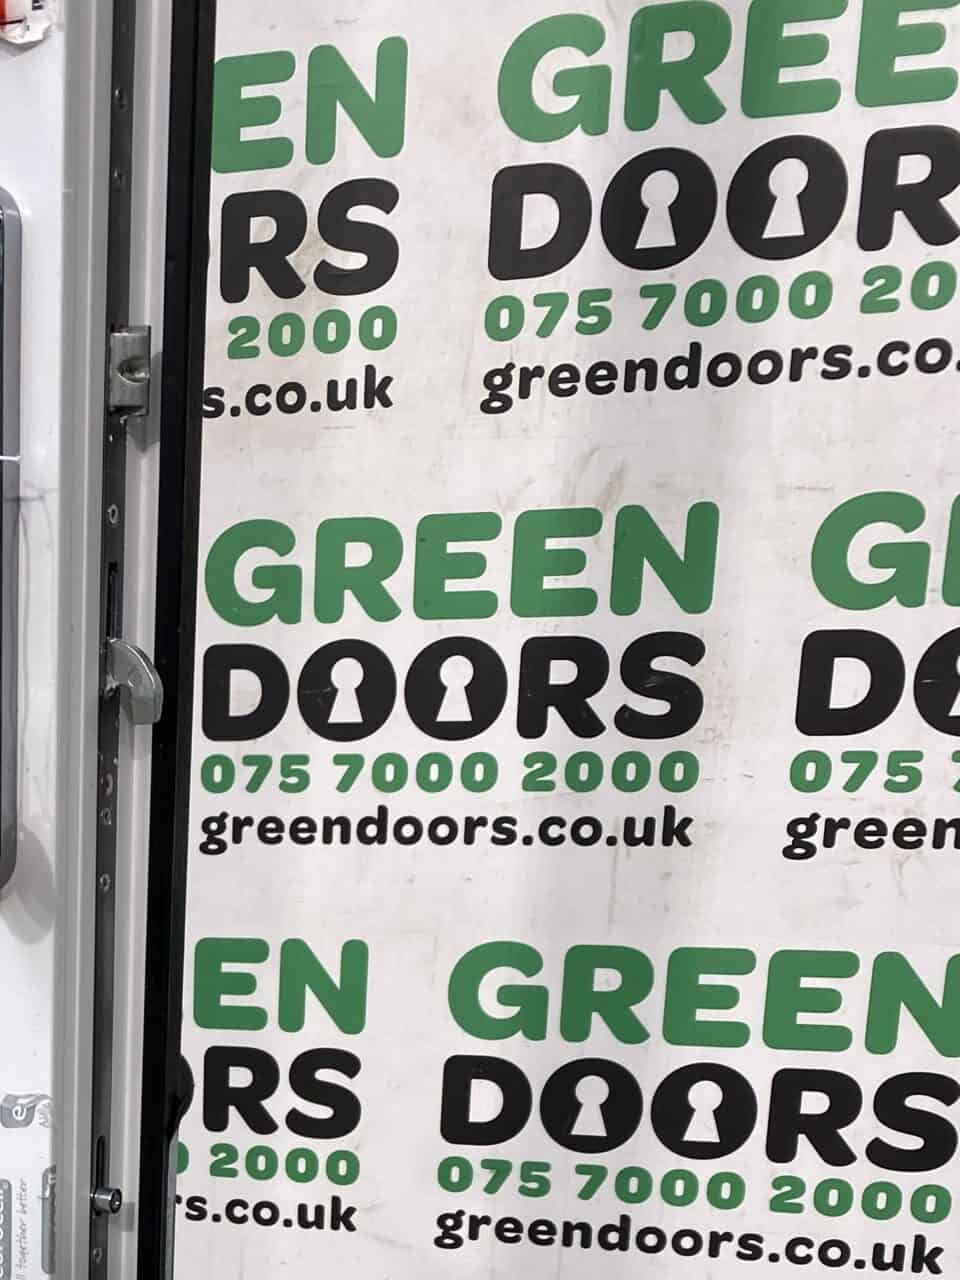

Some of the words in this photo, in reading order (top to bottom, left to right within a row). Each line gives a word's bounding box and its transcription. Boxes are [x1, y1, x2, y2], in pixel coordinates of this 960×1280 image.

[227, 305, 398, 359] 2000
[484, 288, 612, 341] 075
[639, 271, 833, 330] 7000
[204, 499, 721, 629] GREEN
[201, 631, 706, 743] DOORS
[201, 753, 311, 794] 075
[332, 751, 498, 794] 7000
[522, 750, 700, 793] 2000
[790, 750, 924, 794] 075
[199, 804, 694, 856] greendoors.co.uk
[439, 1054, 960, 1173] DOORS
[209, 1142, 360, 1186] 2000
[437, 1155, 550, 1198] 075
[574, 1163, 746, 1210] 7000
[769, 1175, 952, 1224] 2000
[433, 1209, 944, 1275] greendoors.co.uk
